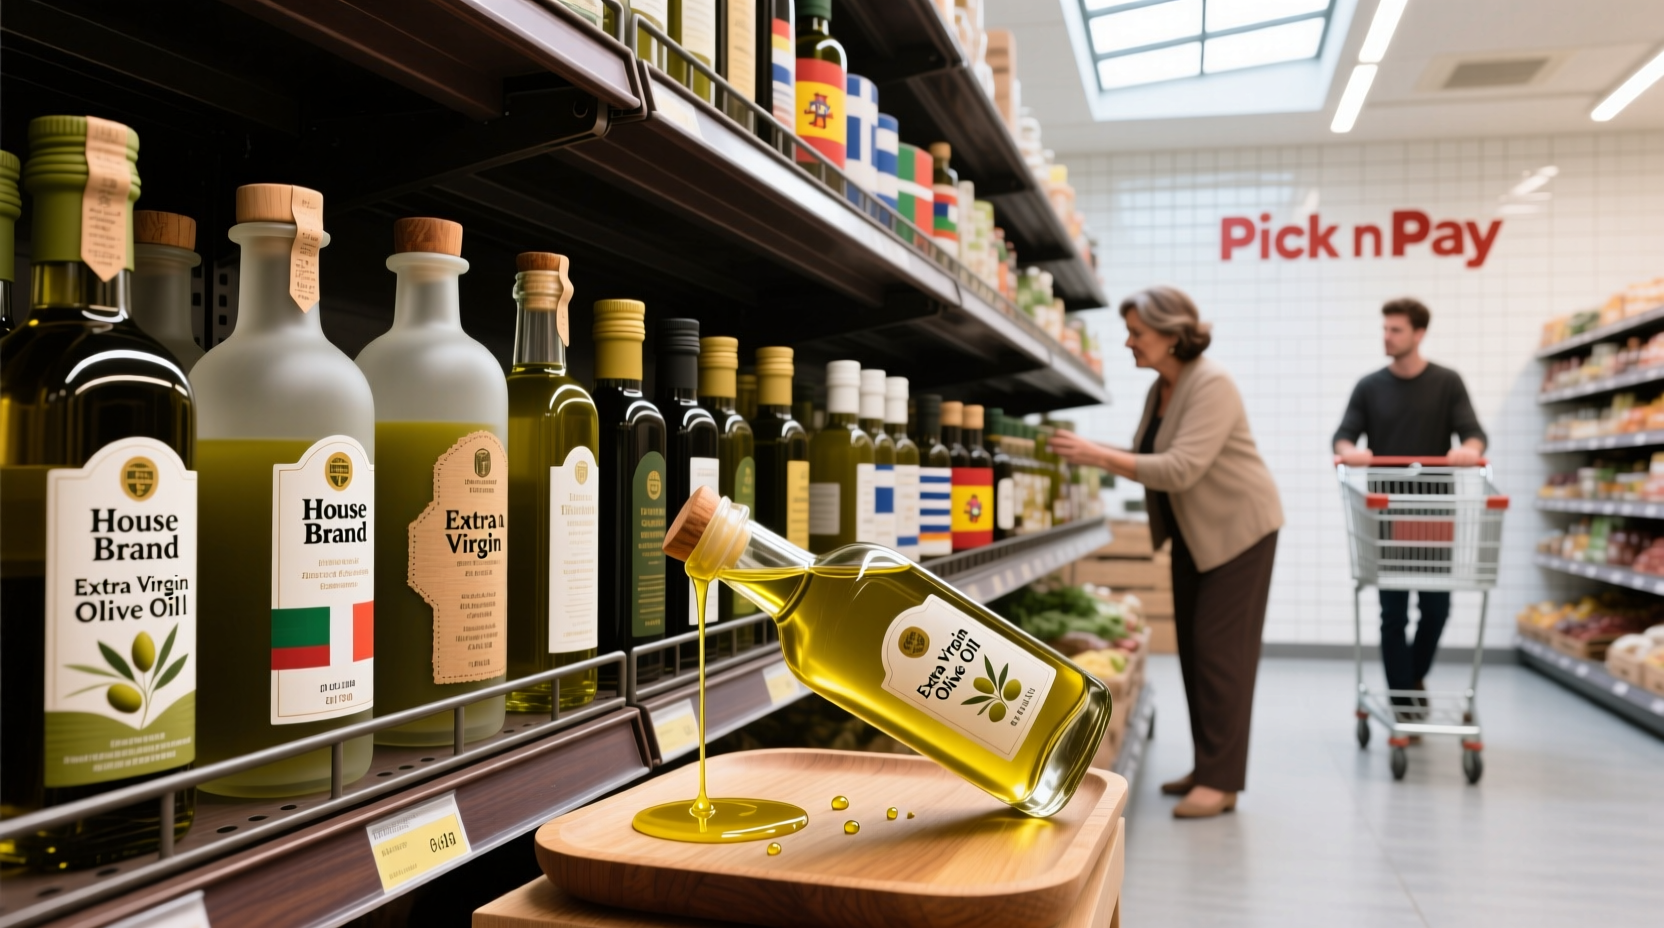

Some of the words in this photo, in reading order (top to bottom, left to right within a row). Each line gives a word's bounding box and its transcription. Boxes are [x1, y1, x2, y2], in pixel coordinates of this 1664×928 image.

[1220, 212, 1341, 262] Pick
[1353, 224, 1383, 258] n
[1391, 210, 1504, 269] Pay
[90, 508, 179, 533] House
[302, 498, 367, 520] House
[445, 509, 497, 530] Extra
[303, 520, 368, 545] Brand
[92, 534, 180, 562] Brand
[445, 532, 502, 560] Virgin
[74, 578, 131, 597] Extra
[136, 574, 189, 597] Virgin
[75, 599, 144, 623] Olive
